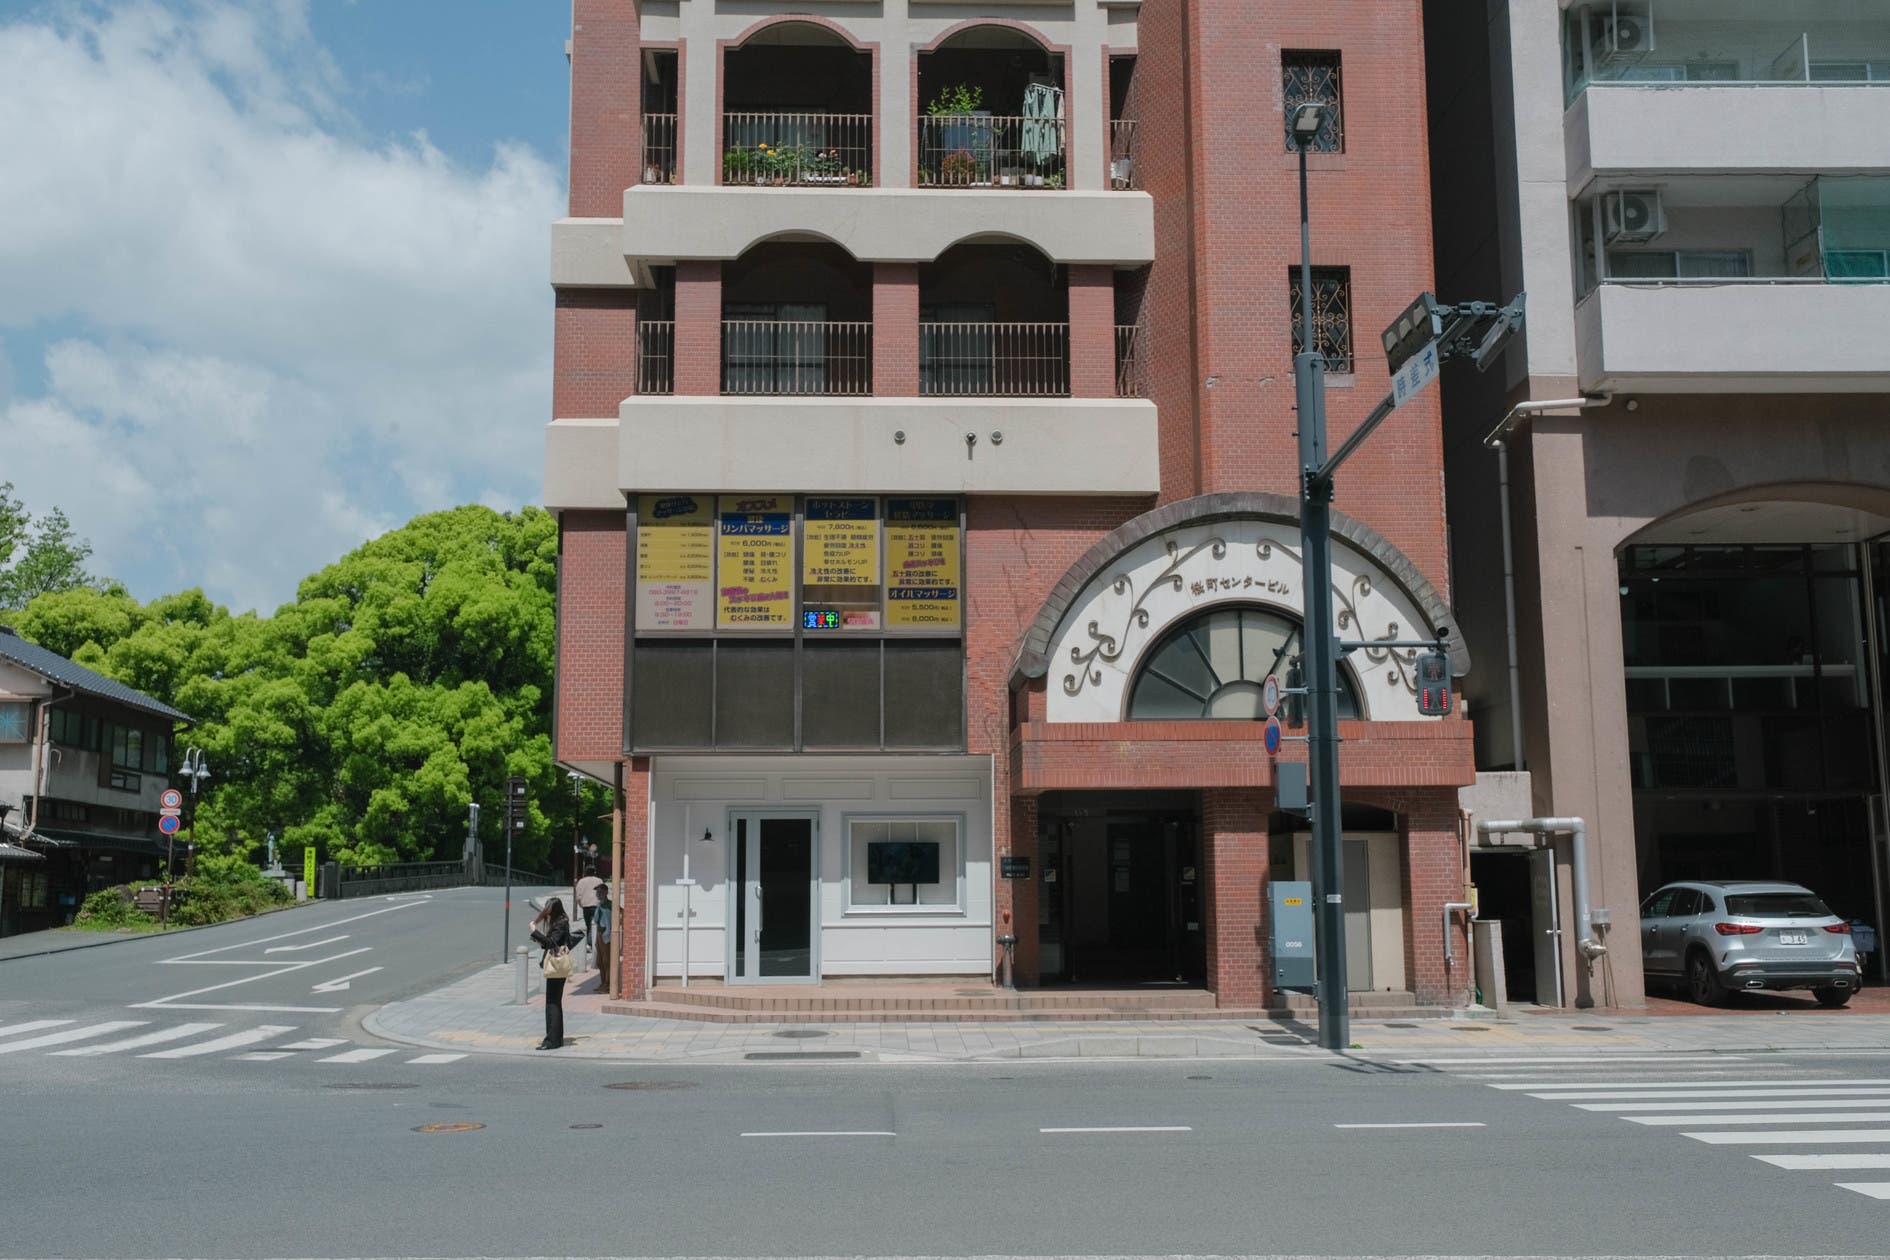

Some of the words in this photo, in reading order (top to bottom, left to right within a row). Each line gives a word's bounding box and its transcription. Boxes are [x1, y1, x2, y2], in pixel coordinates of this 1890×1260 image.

[723, 524, 788, 533] リンパマッサージ
[890, 590, 956, 599] オイルマッサージ
[808, 612, 835, 627] 営業中
